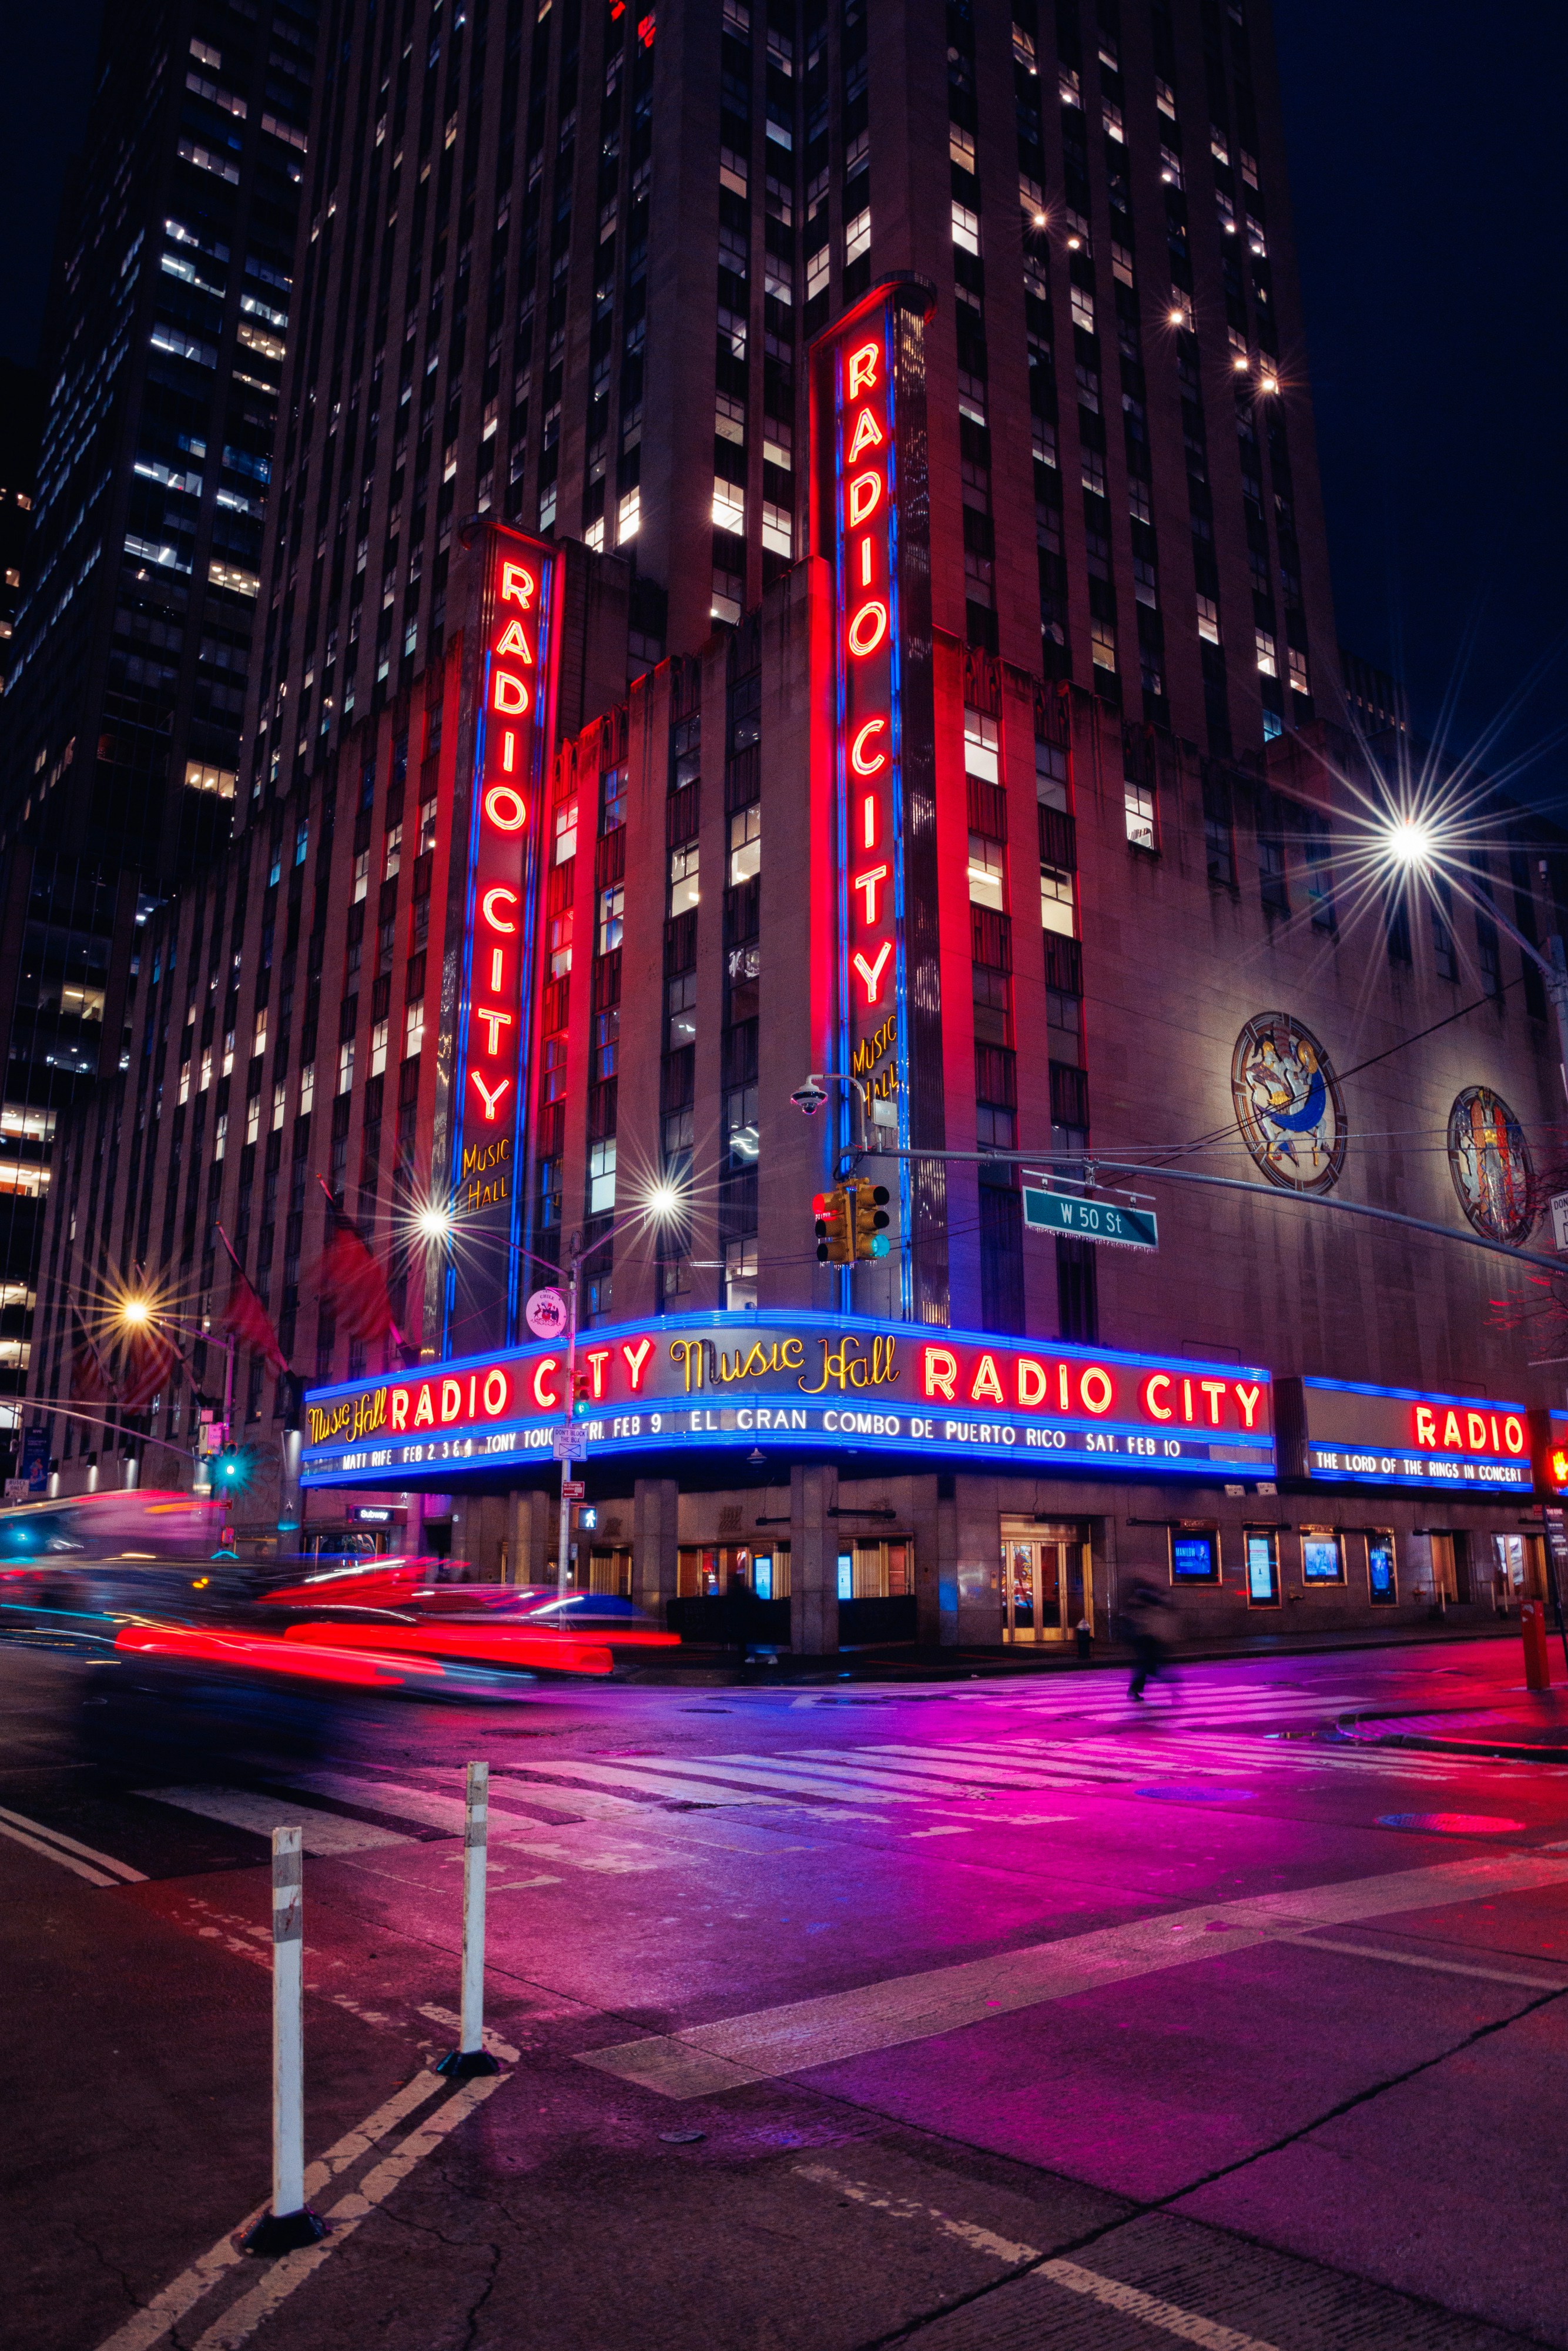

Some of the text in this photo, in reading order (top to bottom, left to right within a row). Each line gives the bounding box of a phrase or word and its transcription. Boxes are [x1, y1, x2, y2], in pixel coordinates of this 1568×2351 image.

[848, 343, 892, 1003] RADIO CITY
[471, 561, 534, 1120] RADIO CITY
[1060, 1203, 1122, 1234] W 50 St
[1554, 1197, 1568, 1210] DON
[392, 1339, 650, 1431] RADIO CTY
[670, 1335, 899, 1394] Music Hall
[925, 1348, 1259, 1427] RADIO CITY
[343, 1452, 367, 1469] MATT
[371, 1449, 392, 1466] RIFE
[403, 1445, 423, 1463] FEB
[487, 1433, 516, 1454] TONY
[524, 1428, 554, 1448] TOUC
[614, 1415, 640, 1437] FEB
[651, 1413, 661, 1433] 9
[692, 1409, 1180, 1457] EL GRAN COMBO DE PUERTO RICO SAT. FEB 10
[1416, 1407, 1523, 1454] RADIO
[1316, 1452, 1522, 1482] THE LORD OF THE RINGS IN CONCERT
[360, 1509, 388, 1521] Subway
